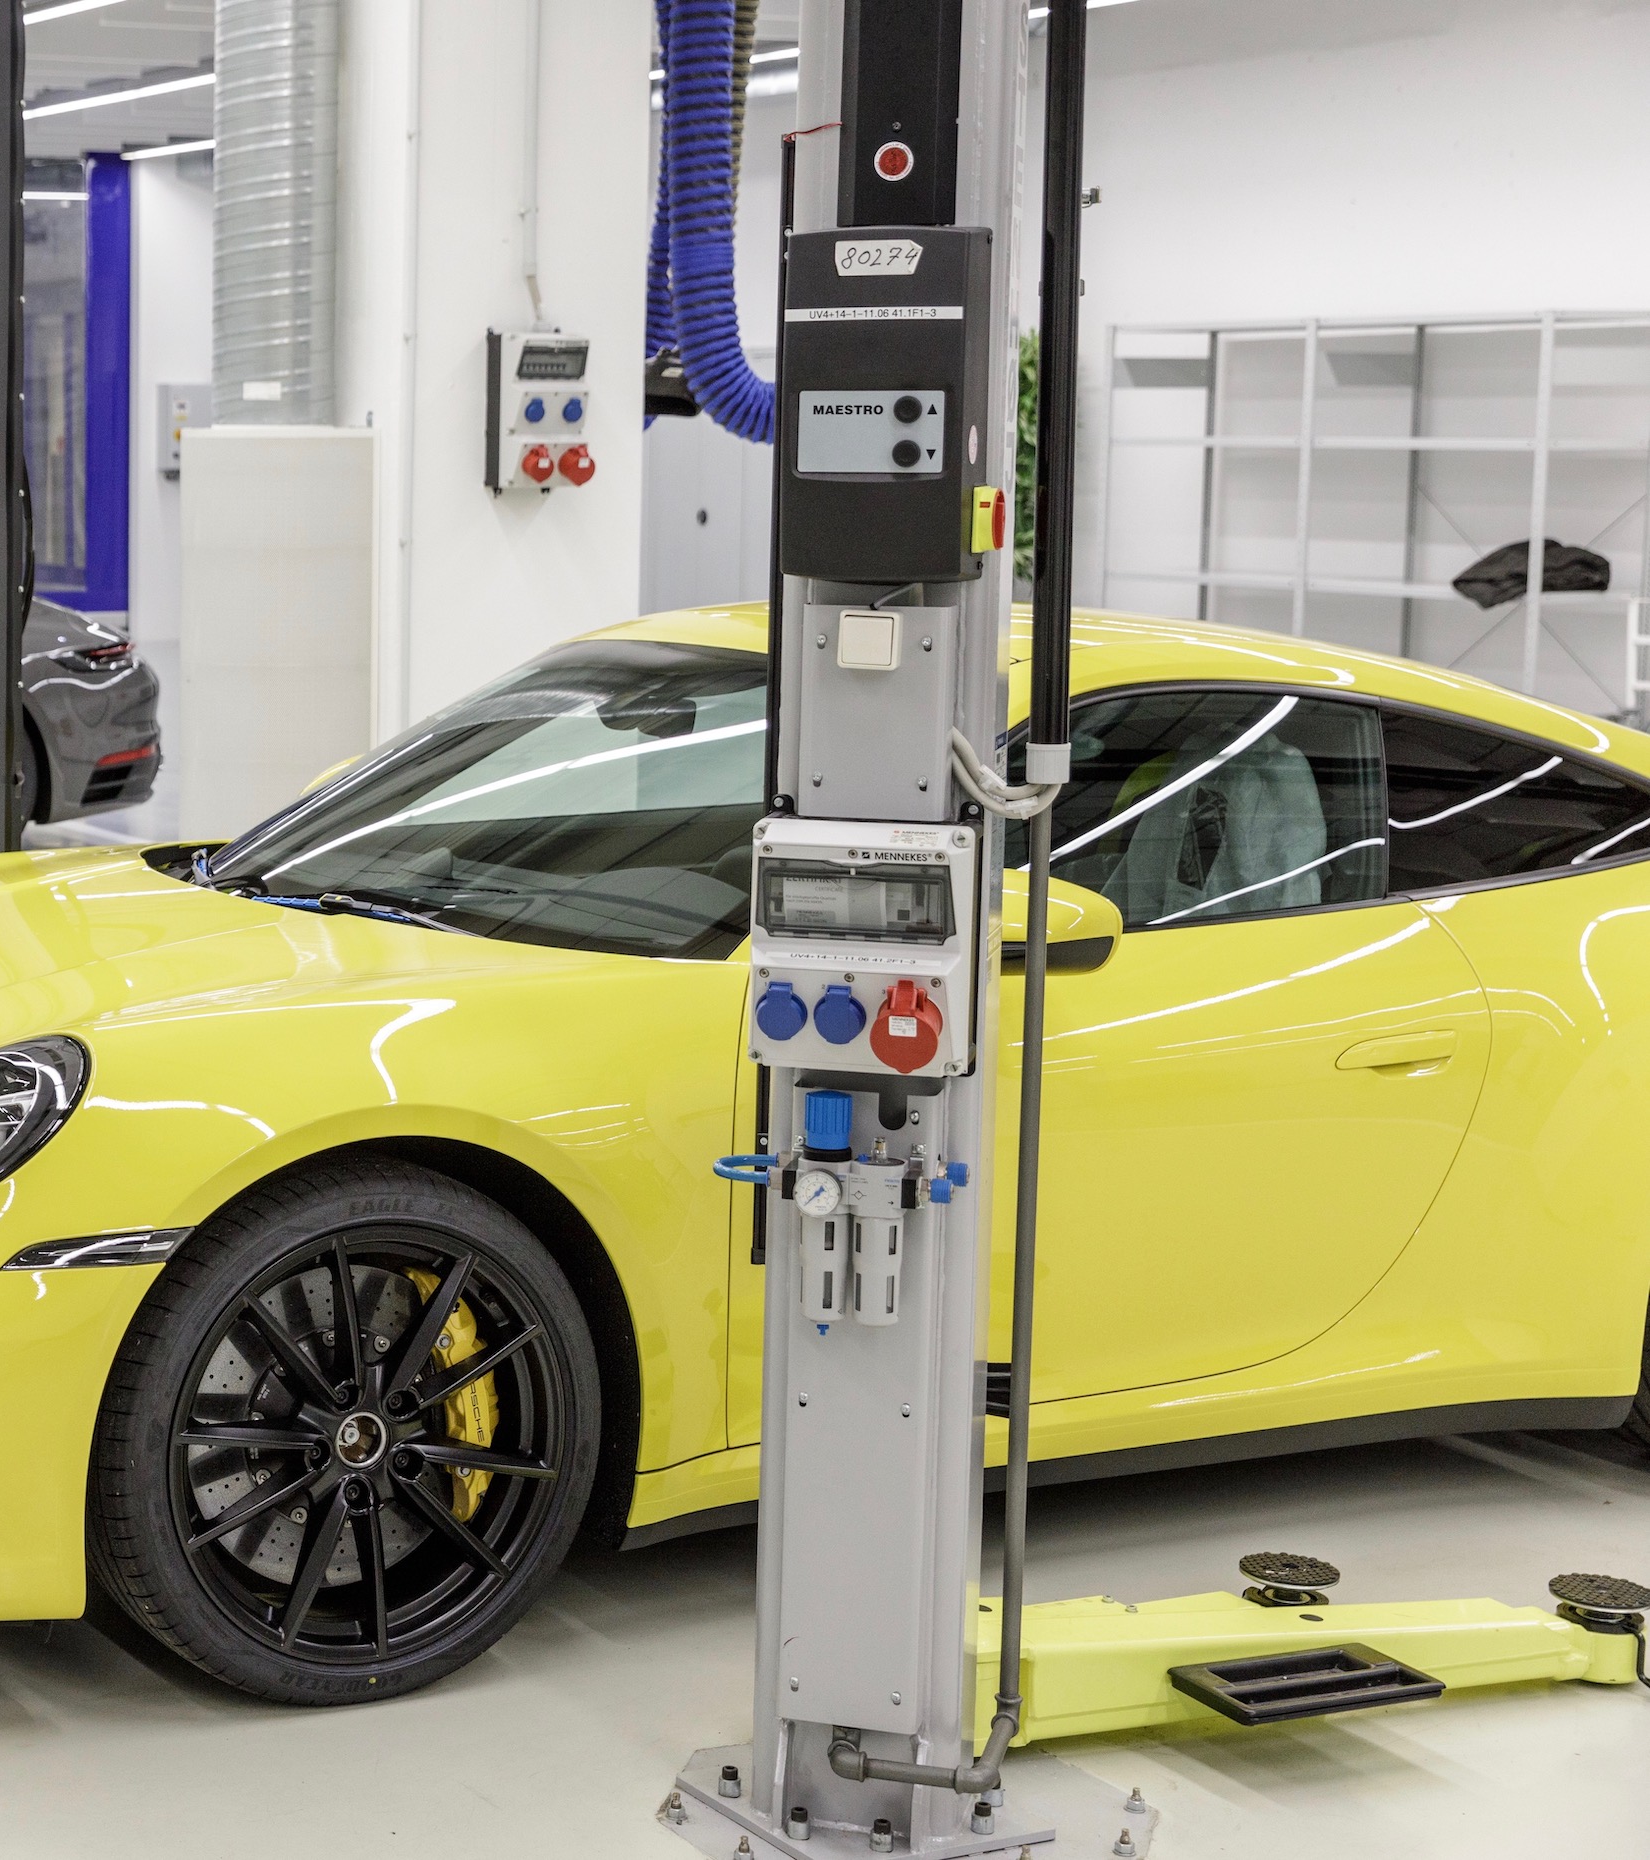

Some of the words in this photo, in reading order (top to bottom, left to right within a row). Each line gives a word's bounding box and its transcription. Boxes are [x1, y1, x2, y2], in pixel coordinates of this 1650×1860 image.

[840, 247, 919, 270] 80274
[892, 309, 937, 318] 41.1F1-3
[813, 405, 884, 415] MAESTRO
[349, 1198, 414, 1216] EAGLE
[470, 1382, 485, 1443] RSCHE
